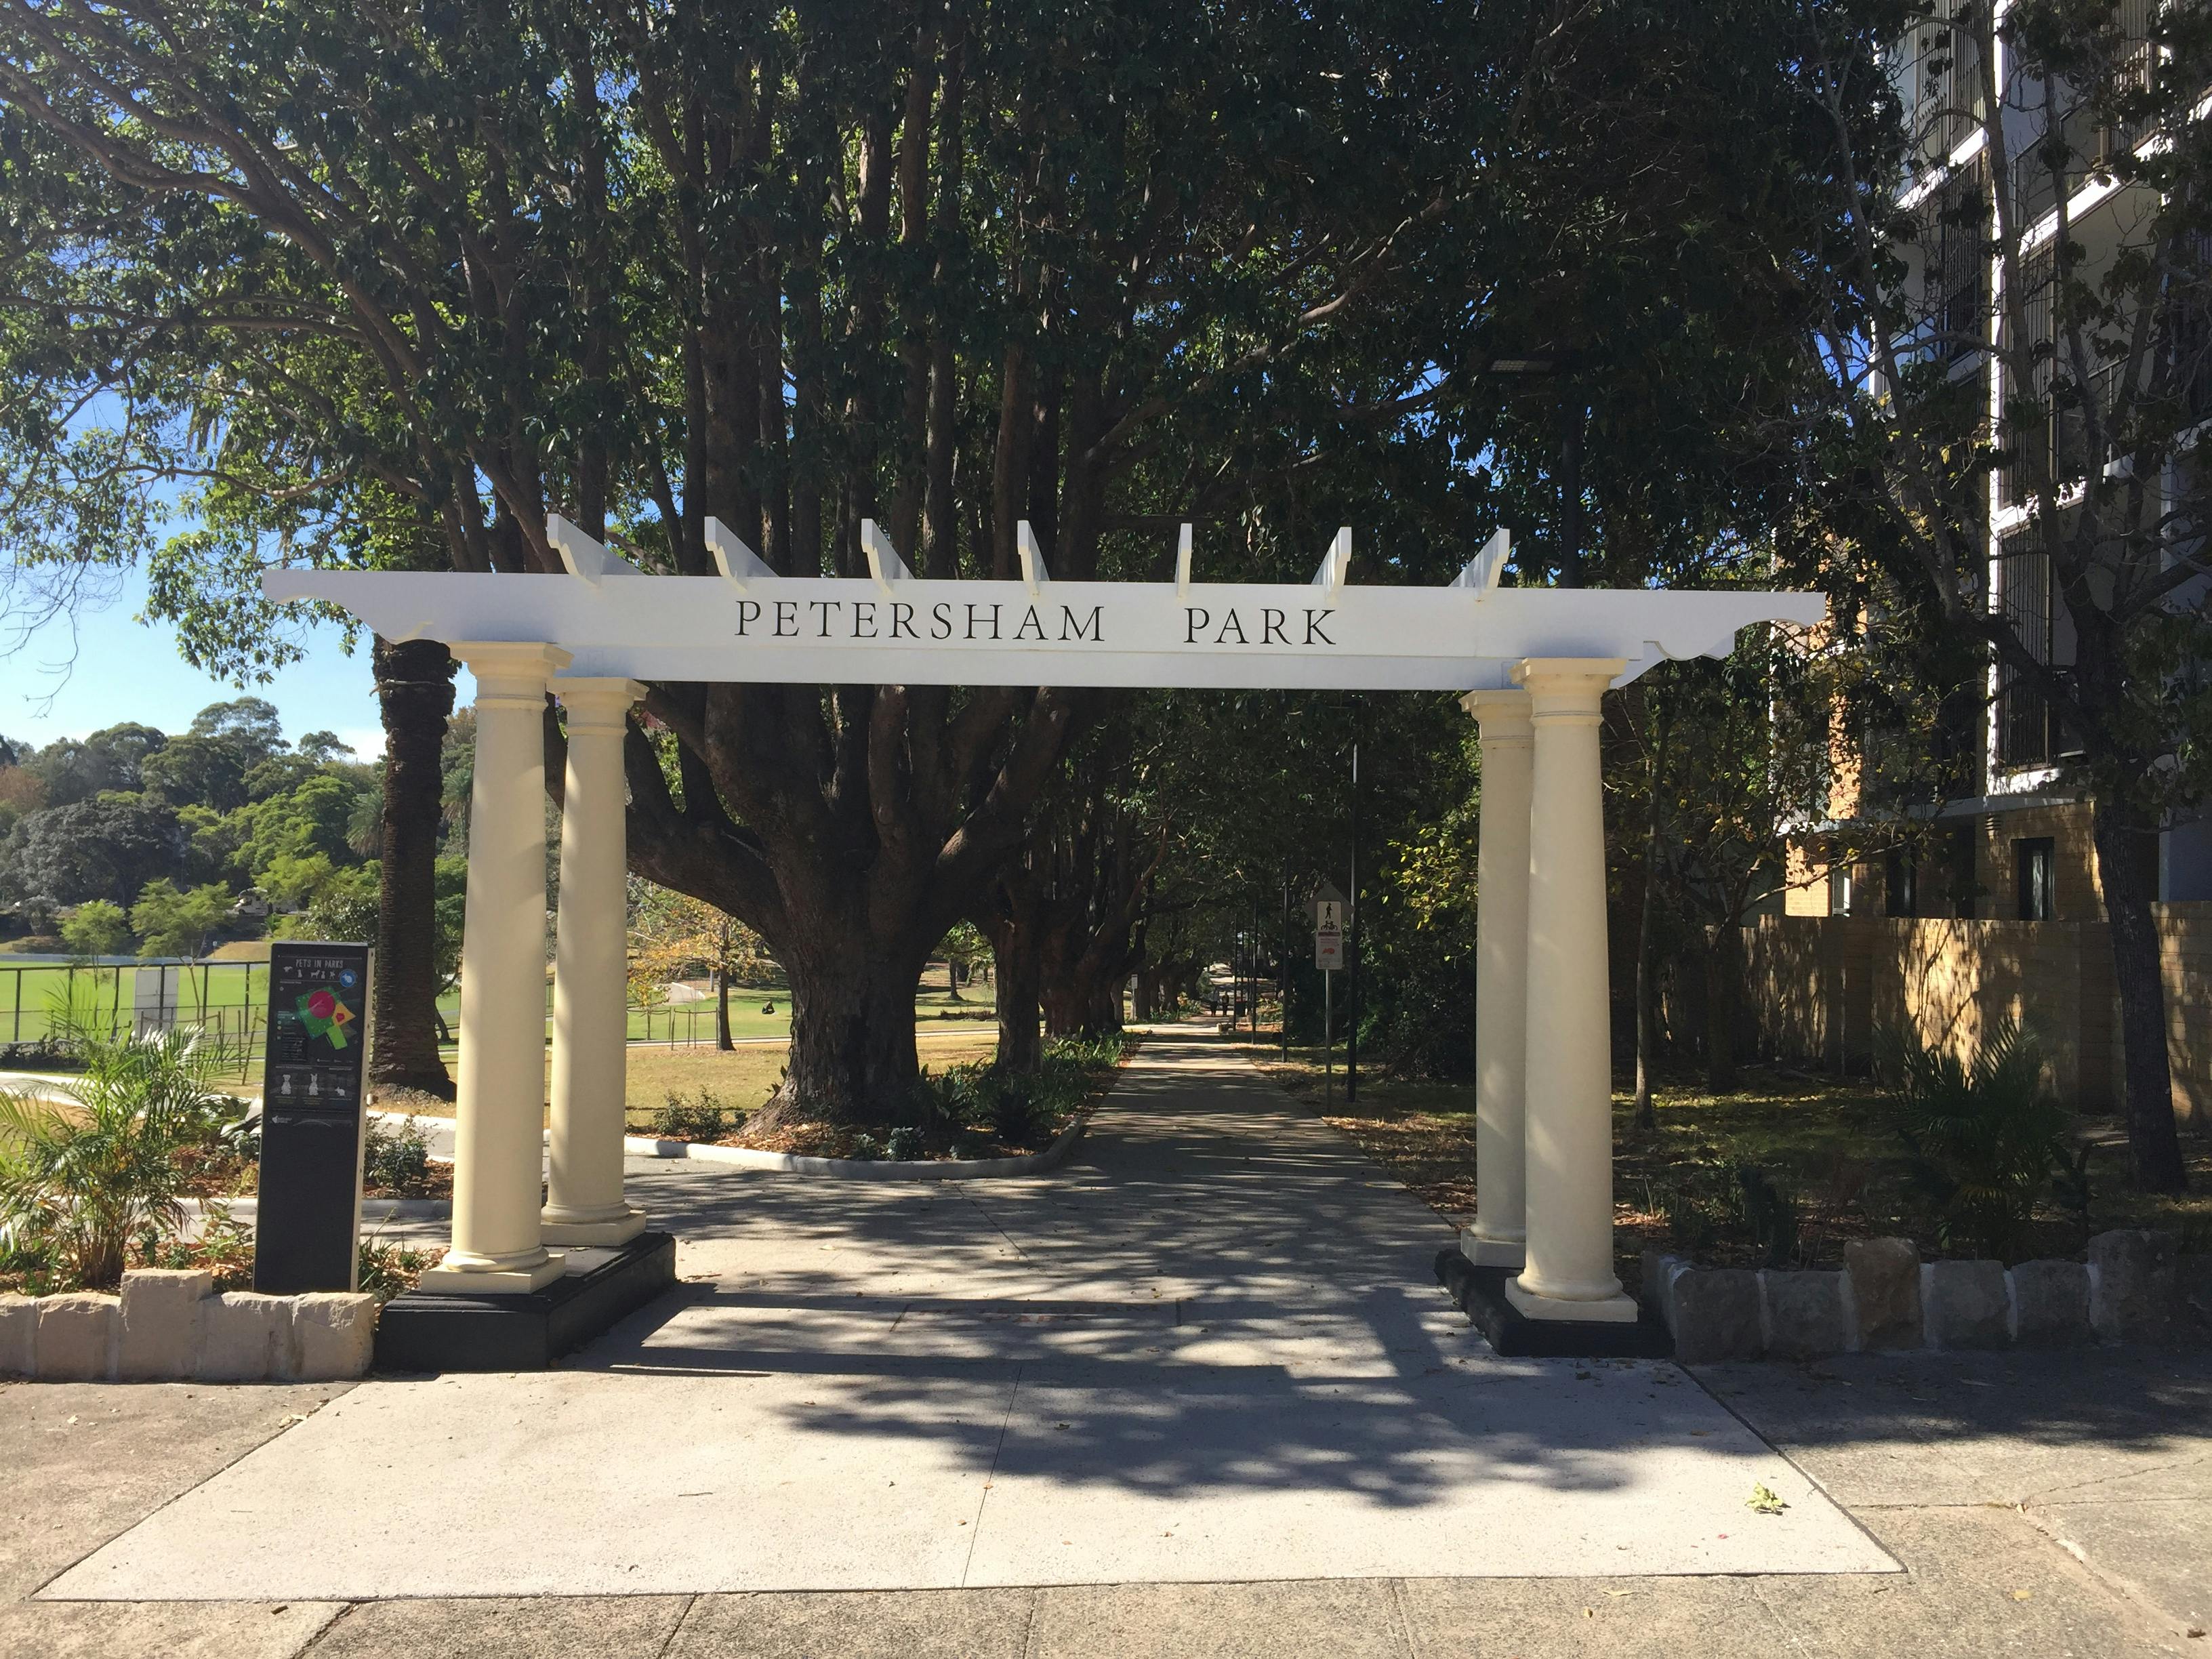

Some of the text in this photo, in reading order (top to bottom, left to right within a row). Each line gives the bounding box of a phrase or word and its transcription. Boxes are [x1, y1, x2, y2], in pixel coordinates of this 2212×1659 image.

[735, 600, 1336, 645] PETERSHAM PARK
[295, 959, 344, 968] PETS IN PARKS
